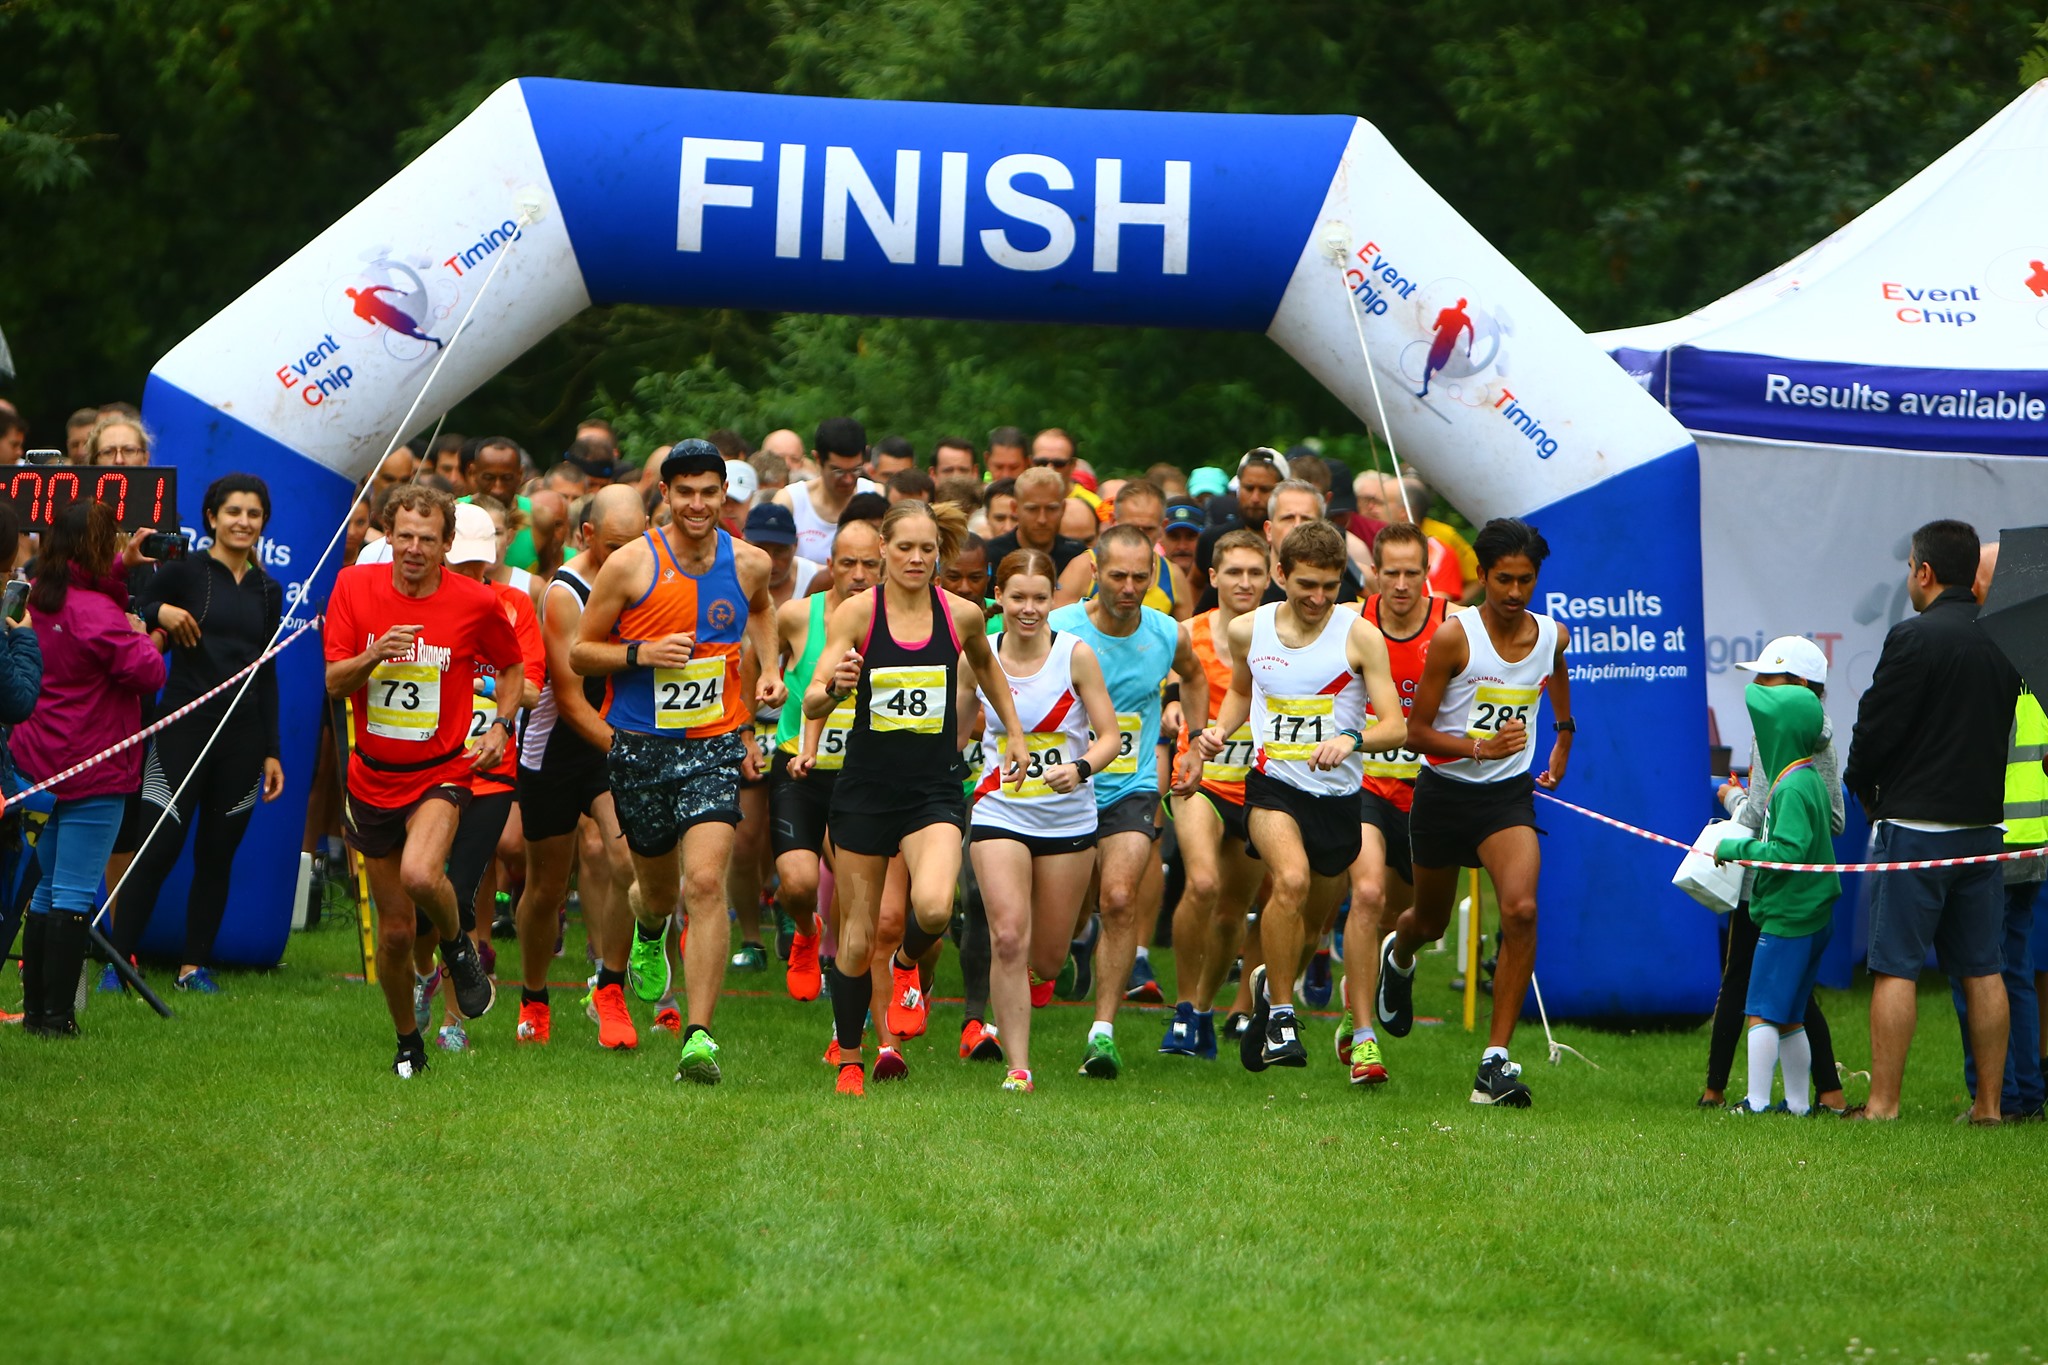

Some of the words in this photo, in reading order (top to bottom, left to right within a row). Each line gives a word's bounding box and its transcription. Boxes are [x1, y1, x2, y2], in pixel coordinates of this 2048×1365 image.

[676, 136, 1191, 275] FINISH
[444, 219, 522, 277] Timing
[1357, 241, 1417, 301] Event
[1342, 268, 1388, 316] Chip
[1882, 282, 1980, 302] Event
[1896, 308, 1976, 326] Chip
[276, 333, 340, 389] Event
[302, 363, 353, 406] Chip
[1765, 373, 1890, 412] Results
[1899, 388, 2046, 421] available
[1493, 388, 1558, 460] Timing
[180, 526, 291, 567] Relts
[1545, 589, 1663, 619] Results
[1663, 625, 1686, 652] at
[1252, 655, 1290, 668] HILLINGDON
[381, 680, 420, 711] 73
[661, 678, 717, 710] 224
[886, 689, 928, 716] 48
[1270, 714, 1322, 742] 171
[1472, 703, 1529, 731] 285
[420, 731, 430, 739] 73
[1209, 740, 1254, 765] 77
